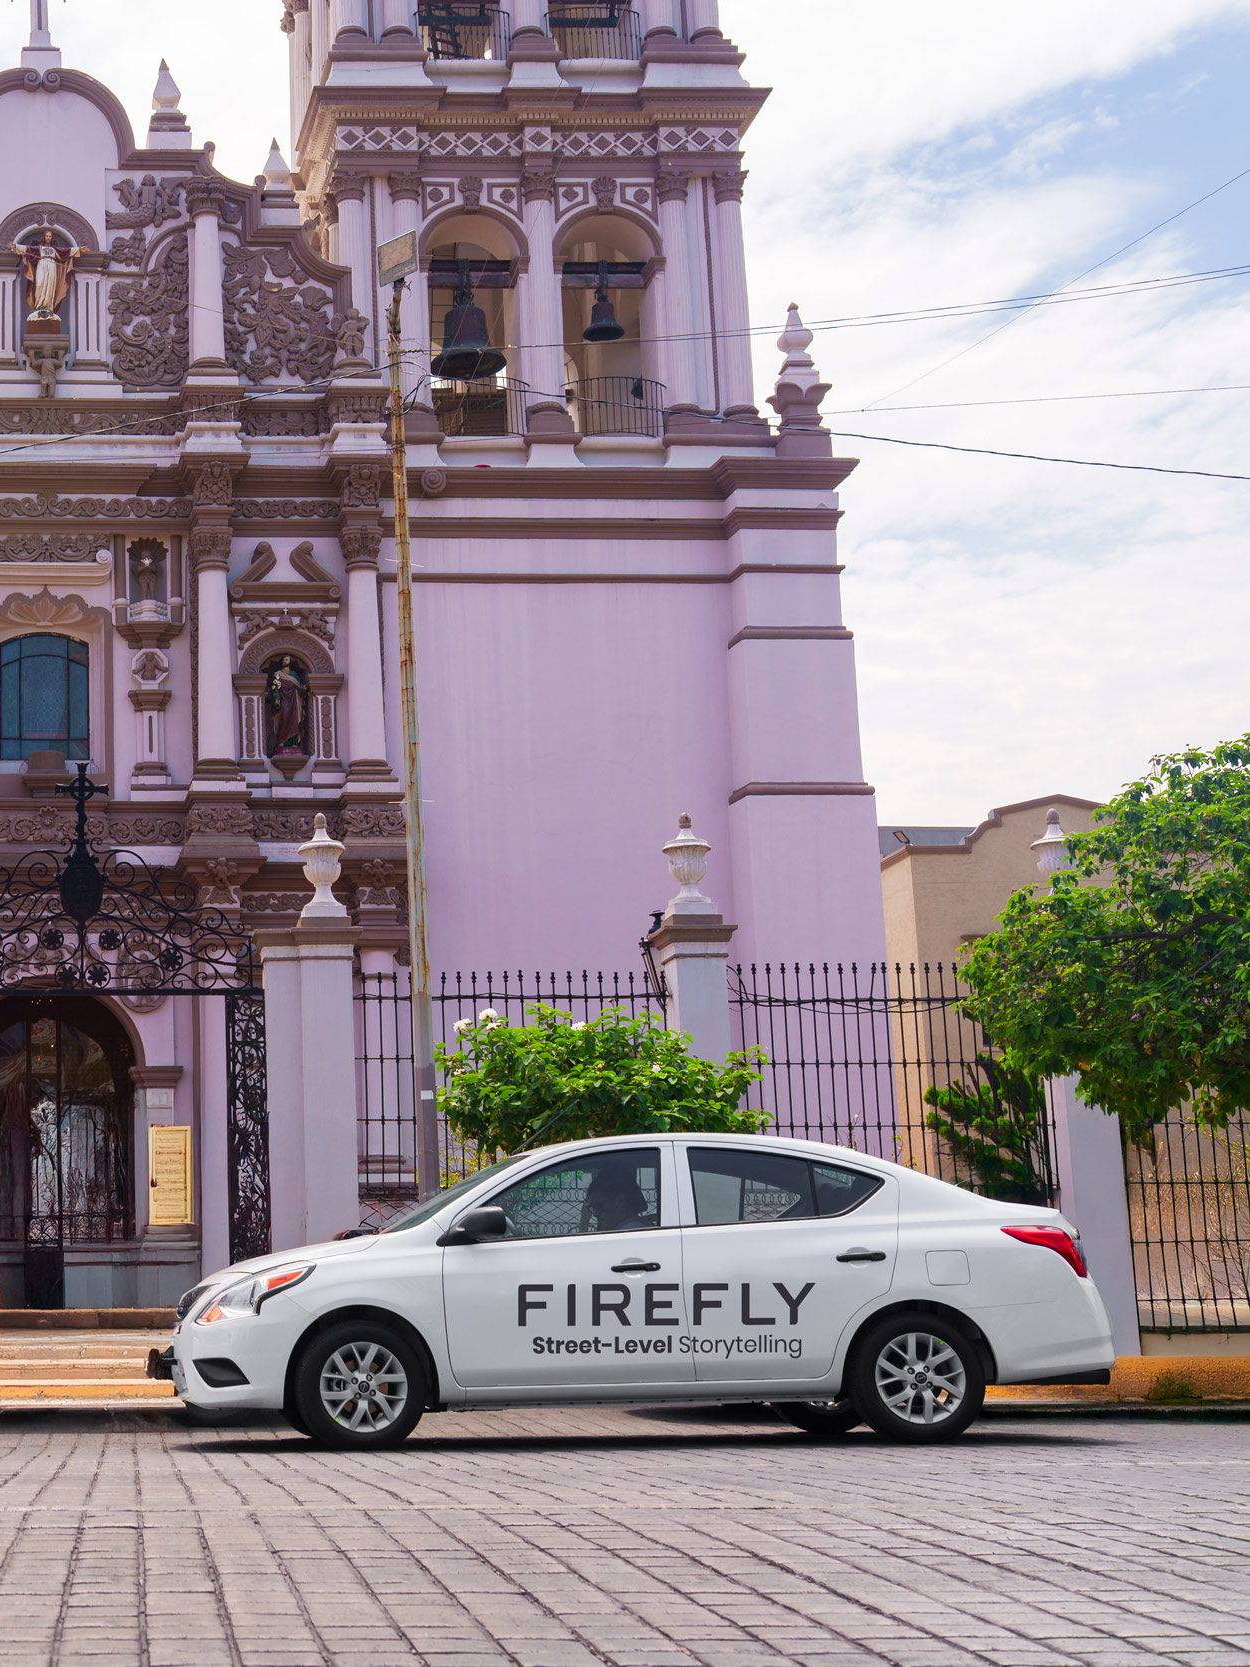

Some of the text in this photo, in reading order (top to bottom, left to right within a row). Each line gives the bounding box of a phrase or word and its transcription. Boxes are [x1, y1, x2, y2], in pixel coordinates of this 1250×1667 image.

[518, 1282, 816, 1327] FIREFLY
[532, 1334, 802, 1359] Street-Level Storytelling
